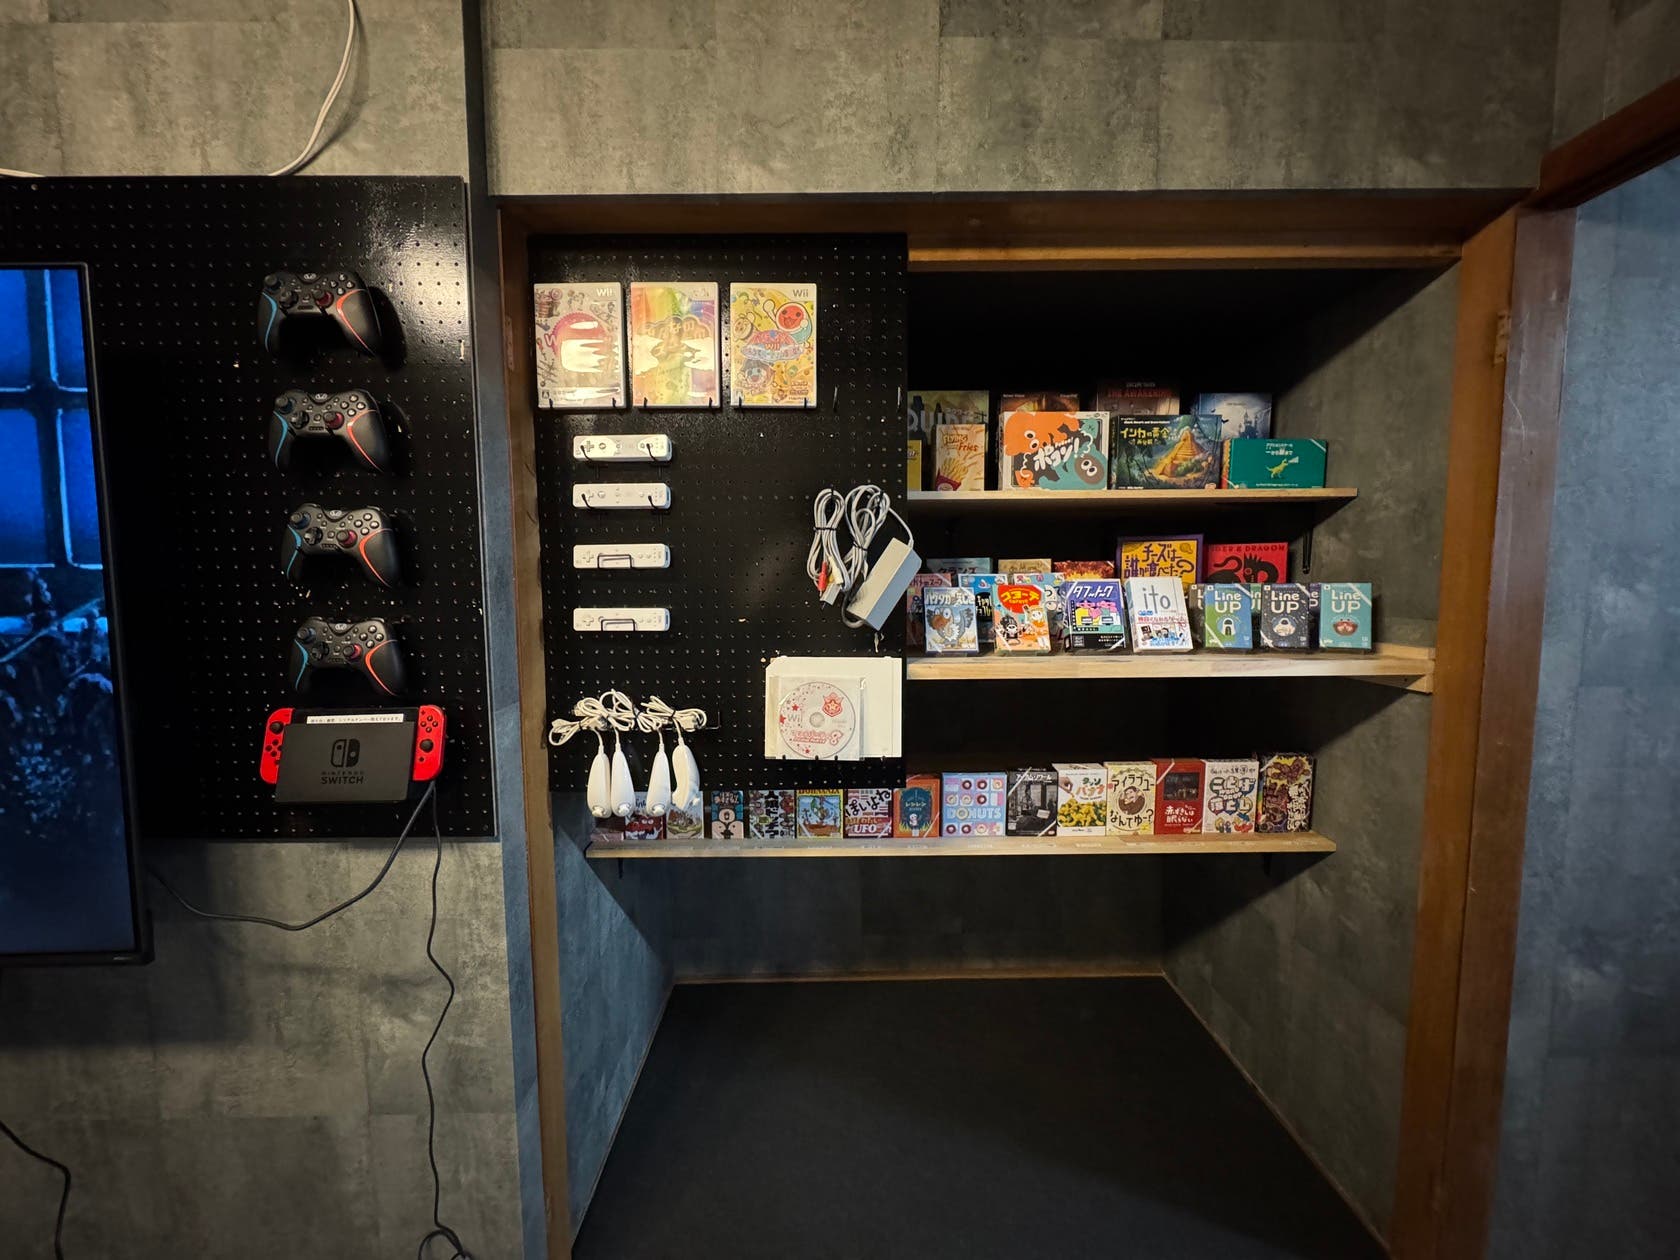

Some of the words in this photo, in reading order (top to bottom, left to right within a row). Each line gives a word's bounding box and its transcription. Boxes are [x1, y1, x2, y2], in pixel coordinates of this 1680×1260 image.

[792, 288, 809, 298] Wii
[1142, 542, 1182, 562] チーズは
[1000, 590, 1040, 603] コヨーテ
[1142, 585, 1171, 614] ito
[1214, 590, 1242, 601] Line
[1271, 590, 1300, 601] Line
[1331, 589, 1361, 600] Line
[1214, 601, 1242, 614] UP
[1270, 601, 1300, 614] UP
[1331, 600, 1361, 614] UP
[320, 775, 364, 785] SWITCH
[946, 806, 1004, 822] DONUTS
[854, 824, 876, 833] UFO
